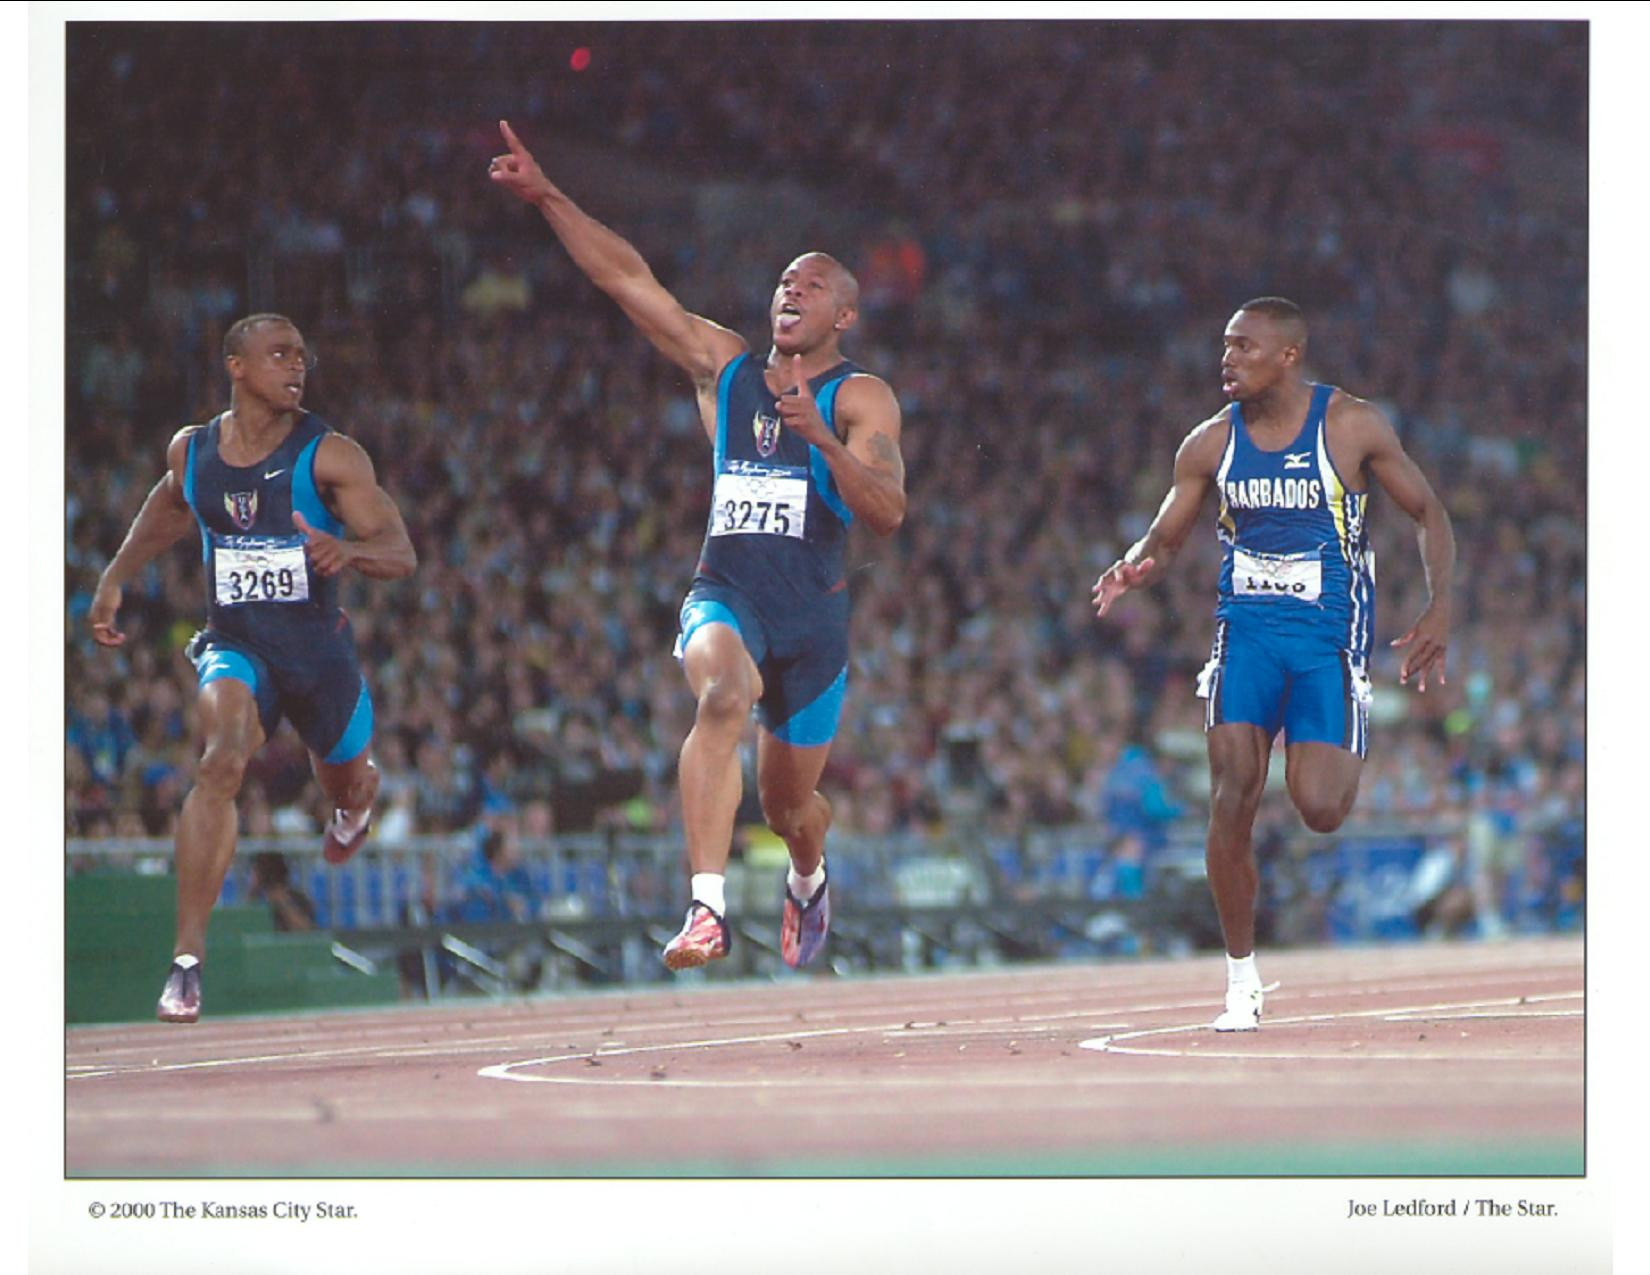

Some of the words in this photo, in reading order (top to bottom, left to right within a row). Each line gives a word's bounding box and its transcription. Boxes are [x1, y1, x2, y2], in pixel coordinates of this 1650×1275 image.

[1227, 477, 1321, 509] BARBADOS
[724, 500, 790, 534] 3275
[229, 568, 293, 601] 3269
